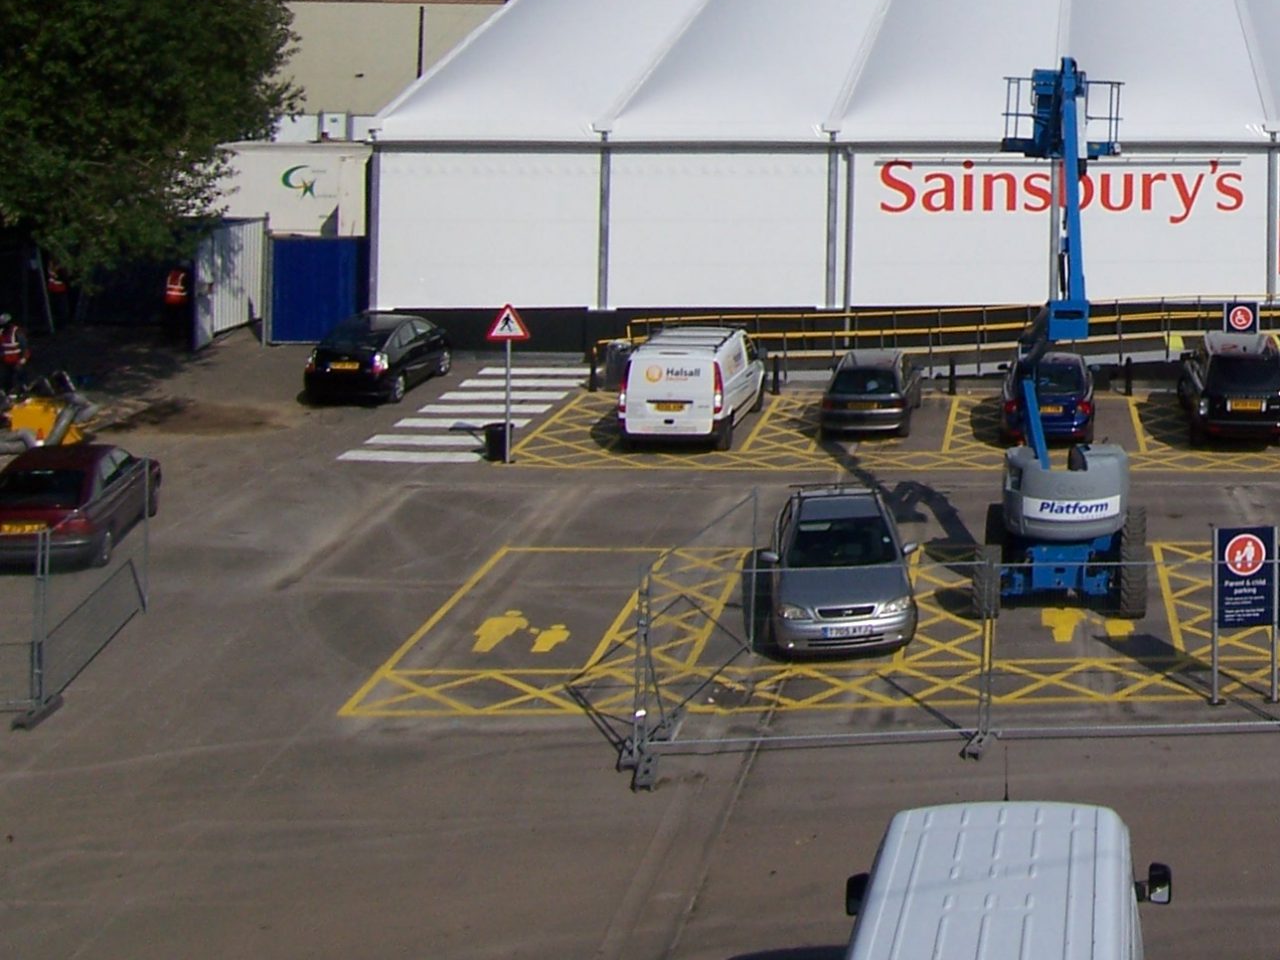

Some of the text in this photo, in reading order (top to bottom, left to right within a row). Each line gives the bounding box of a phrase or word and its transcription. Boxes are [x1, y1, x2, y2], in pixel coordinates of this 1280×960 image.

[880, 159, 1244, 223] Sainsbury's
[666, 367, 701, 377] Halsall
[1039, 501, 1109, 514] Platform
